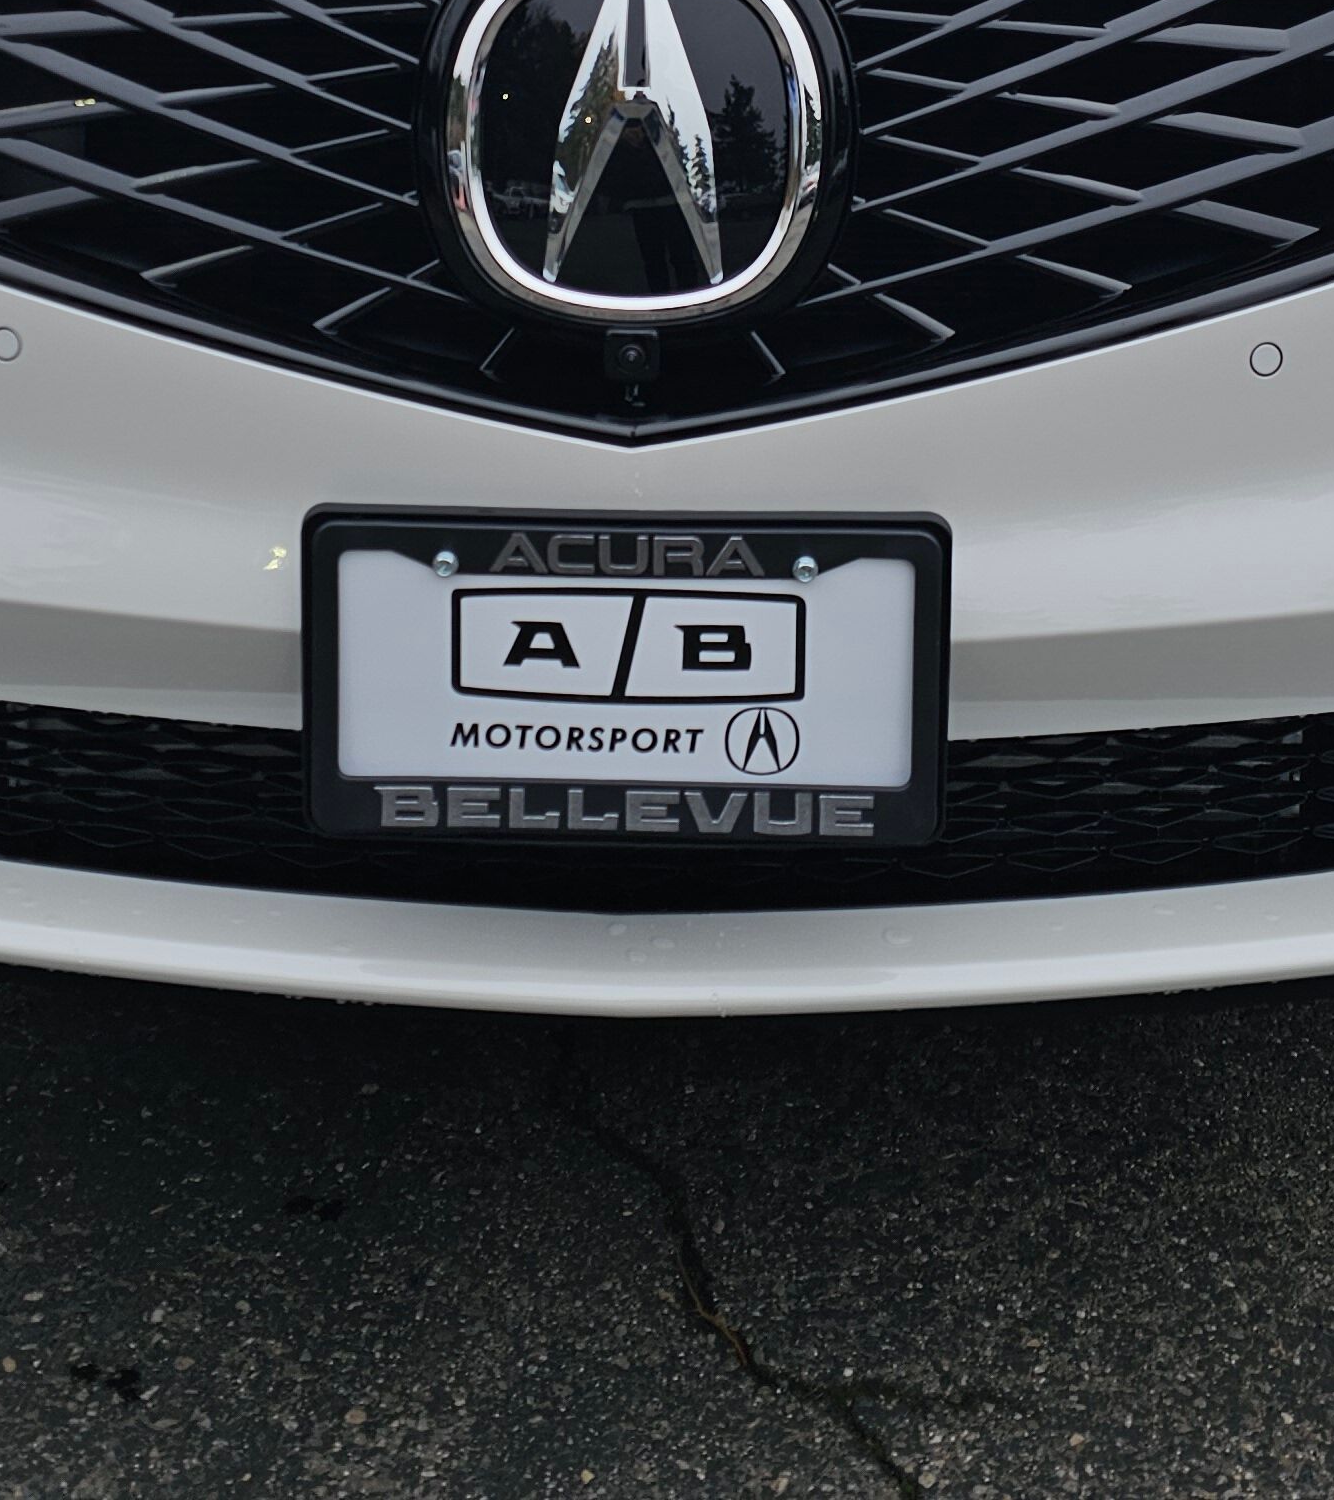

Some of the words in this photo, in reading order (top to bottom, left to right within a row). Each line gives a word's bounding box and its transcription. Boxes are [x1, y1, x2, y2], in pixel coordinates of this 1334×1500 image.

[489, 532, 766, 577] ACURA
[450, 722, 705, 755] MOTORSPORT
[374, 785, 875, 838] BELLEVUE
